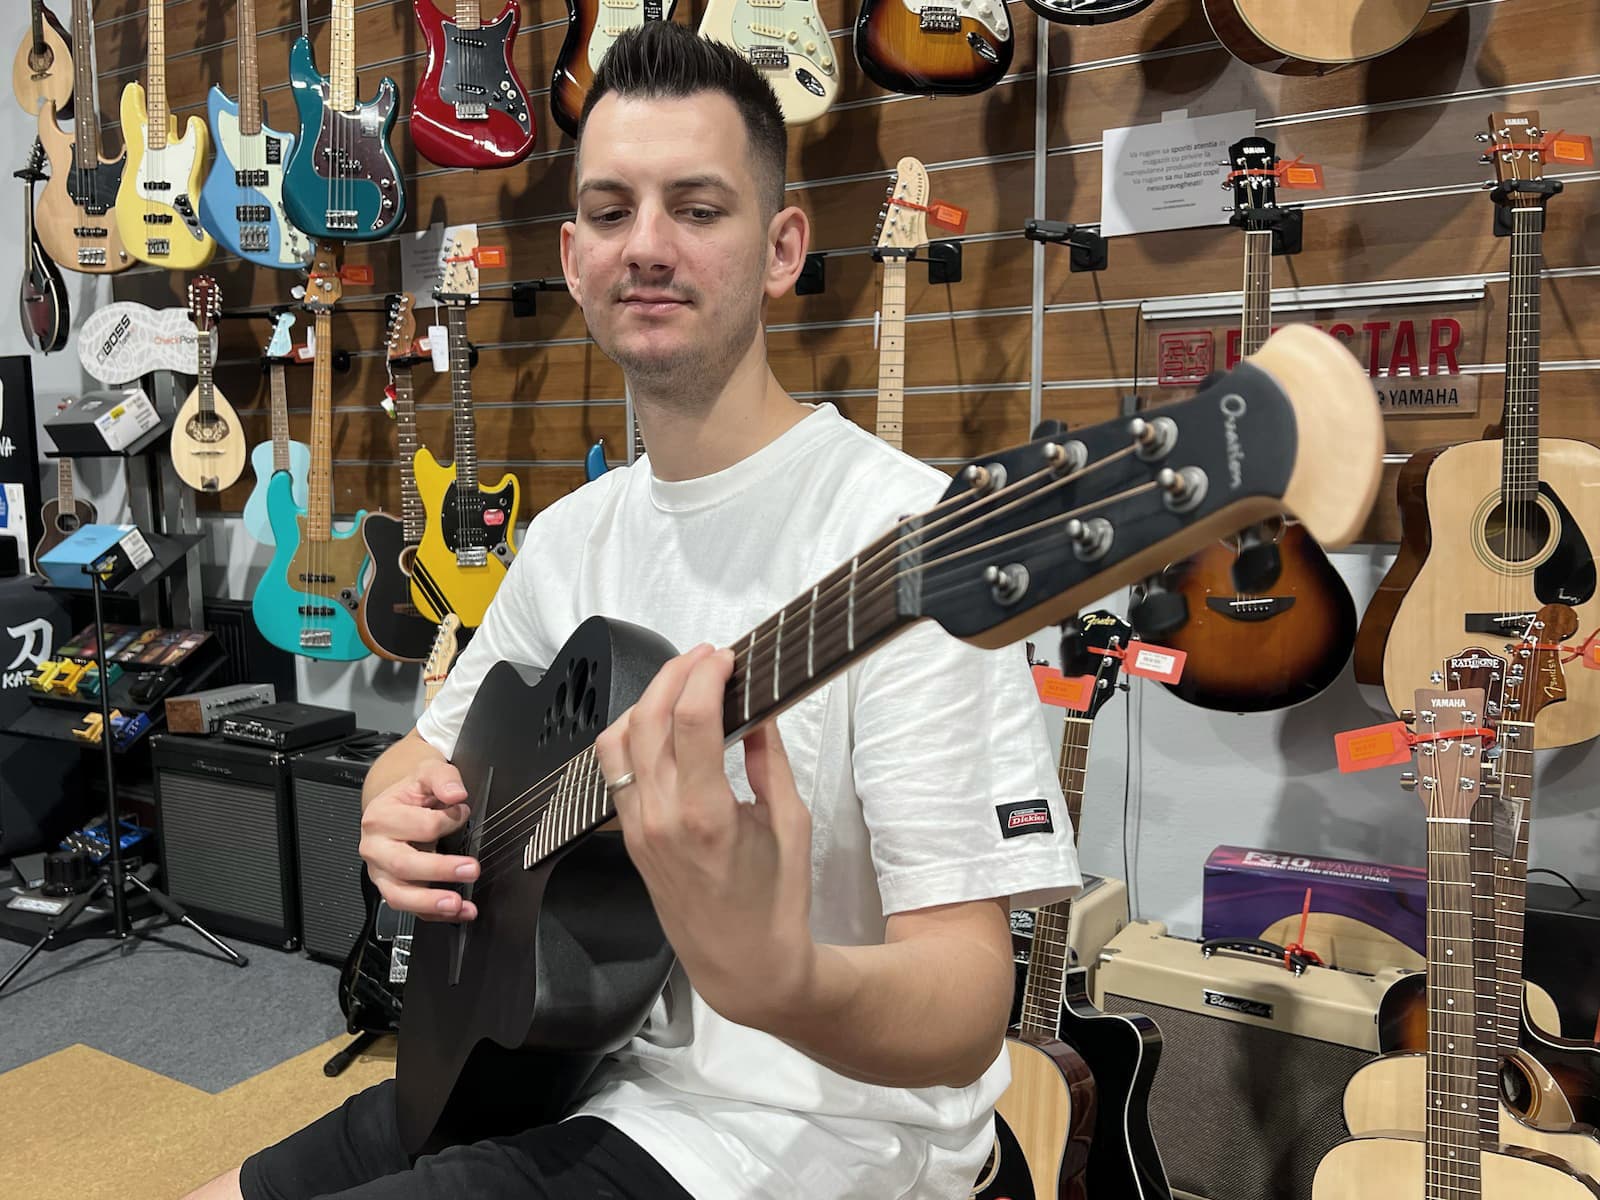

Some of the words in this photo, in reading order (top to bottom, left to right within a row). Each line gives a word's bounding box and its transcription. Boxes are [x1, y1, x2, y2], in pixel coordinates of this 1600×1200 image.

[103, 314, 131, 356] BOSS
[154, 335, 198, 345] CheckPoin
[1389, 388, 1459, 406] YAMAHA
[1083, 614, 1116, 631] Fender
[1431, 698, 1467, 708] YAMAHA
[1012, 814, 1046, 825] Dickies
